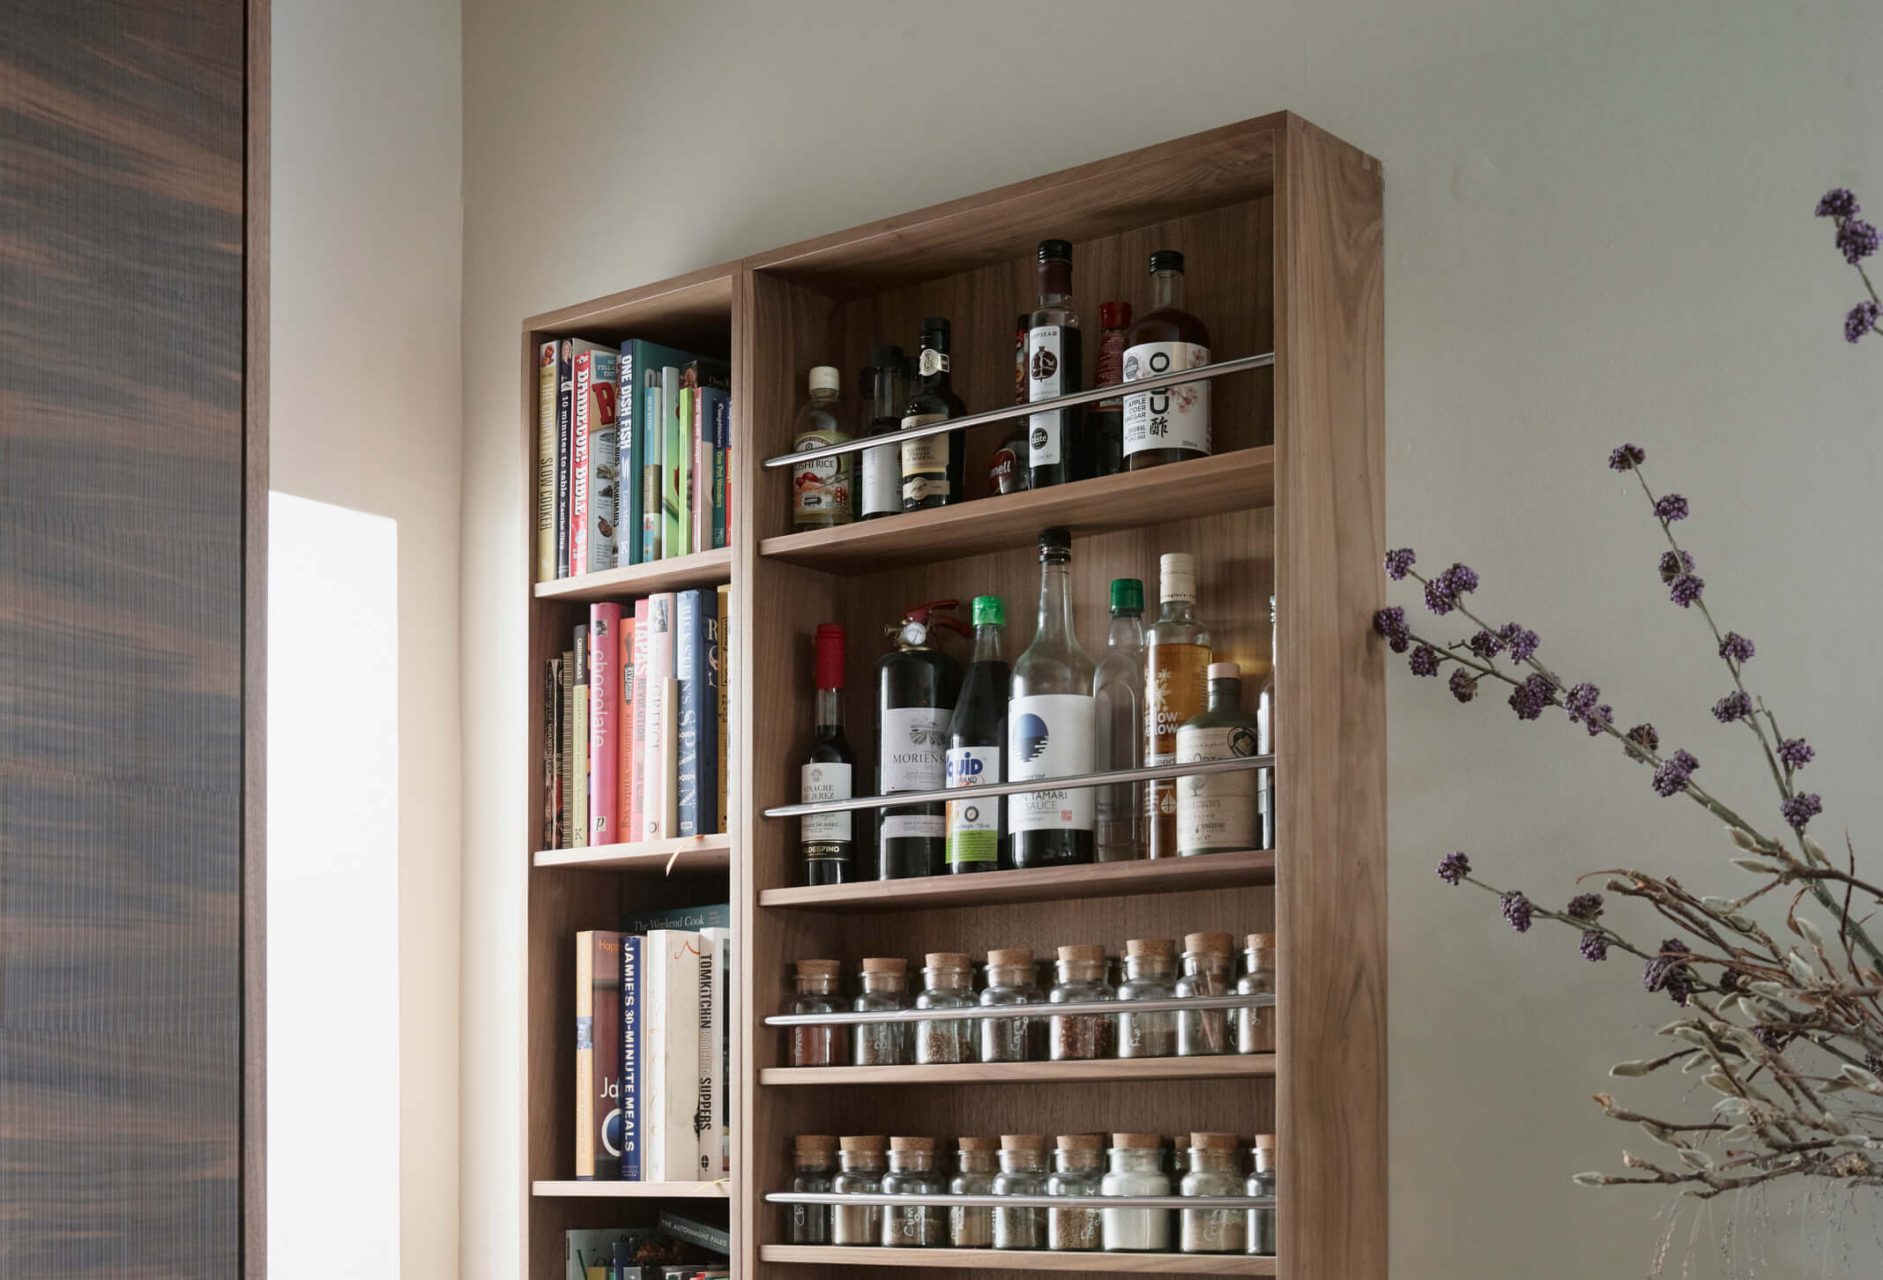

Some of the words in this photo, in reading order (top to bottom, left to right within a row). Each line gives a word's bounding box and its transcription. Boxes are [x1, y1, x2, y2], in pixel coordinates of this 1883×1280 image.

[621, 355, 633, 383] ONE
[1149, 352, 1170, 415] OU
[562, 396, 570, 408] 10
[620, 385, 633, 419] DISH
[561, 411, 569, 454] minutes
[620, 420, 632, 450] FISH
[541, 458, 553, 489] SLOW
[561, 455, 568, 468] to
[815, 460, 835, 469] RICE
[560, 469, 568, 498] table
[574, 468, 587, 516] BIBLE
[715, 479, 723, 509] Wonders
[540, 490, 553, 532] COOKER
[683, 604, 692, 641] RICK
[635, 619, 648, 677] TAPAS
[682, 644, 692, 705] STEIN'S
[592, 649, 609, 748] chocolate
[636, 678, 647, 742] REVOLUTION
[678, 709, 698, 809] SPAIN
[811, 792, 834, 800] JEREZ
[1025, 800, 1058, 811] SAUCE
[1032, 790, 1068, 801] TAMARI
[622, 810, 632, 829] veg
[684, 914, 706, 928] Cook
[623, 943, 636, 1007] JAMIE'S
[623, 1010, 636, 1093] 30-MINUTE
[700, 1077, 712, 1131] SUPPERS
[623, 1096, 636, 1152] MEALS
[673, 1223, 709, 1242] AUTOIMMUNE
[709, 1235, 728, 1247] PALEO
